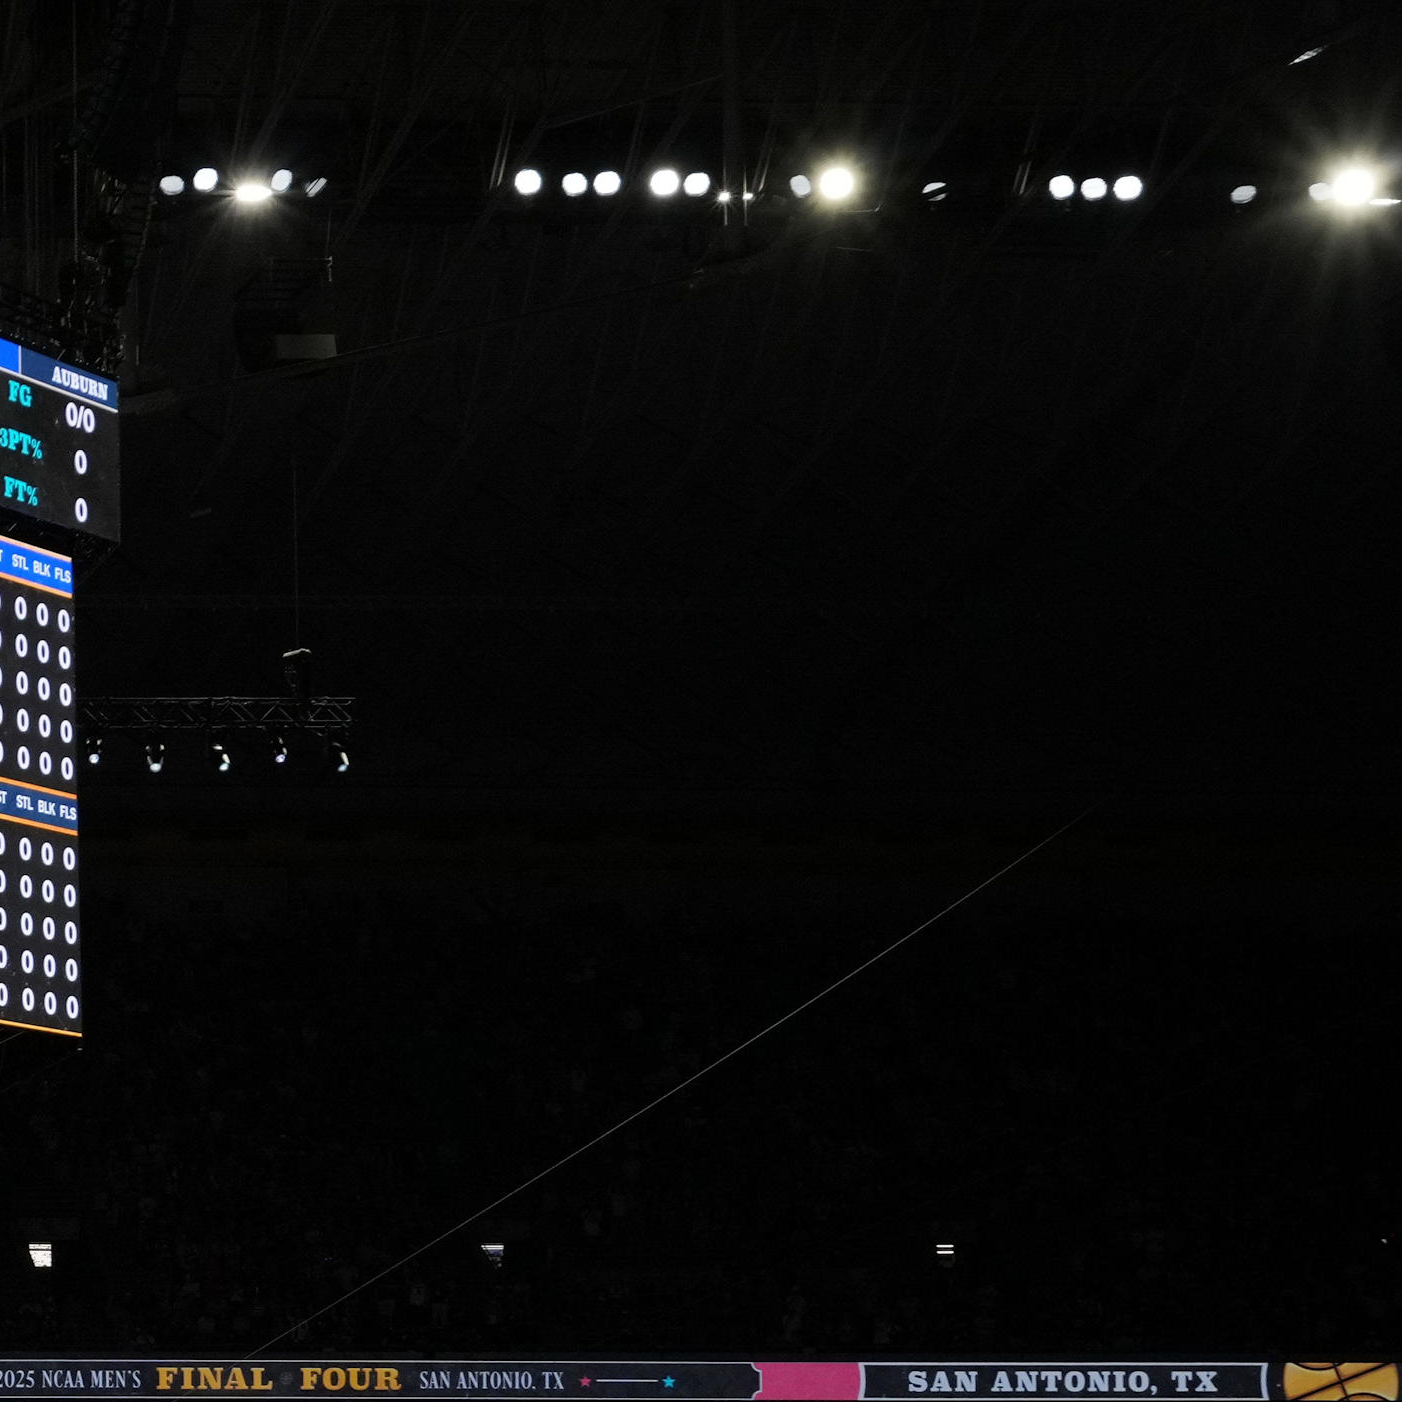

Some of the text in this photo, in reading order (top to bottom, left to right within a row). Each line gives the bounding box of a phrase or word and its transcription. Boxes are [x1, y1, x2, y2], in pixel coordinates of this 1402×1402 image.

[51, 364, 109, 402] AUBURN
[8, 379, 32, 408] FG
[65, 401, 96, 434] 0/0
[0, 427, 43, 462] 3PT%
[3, 474, 39, 508] FT%
[12, 553, 28, 571] STL
[33, 560, 51, 578] BLK
[54, 566, 72, 584] FLS
[16, 794, 34, 811] STL
[37, 800, 56, 816] BLK
[60, 805, 77, 821] FLS
[41, 1370, 85, 1388] NCAA
[90, 1370, 141, 1388] MEN'S
[156, 1367, 273, 1390] FINAL
[300, 1367, 402, 1390] FOUR
[419, 1371, 451, 1389] SAN
[543, 1371, 565, 1389] TX
[908, 1371, 1218, 1395] SAN ANTONIO, TX
